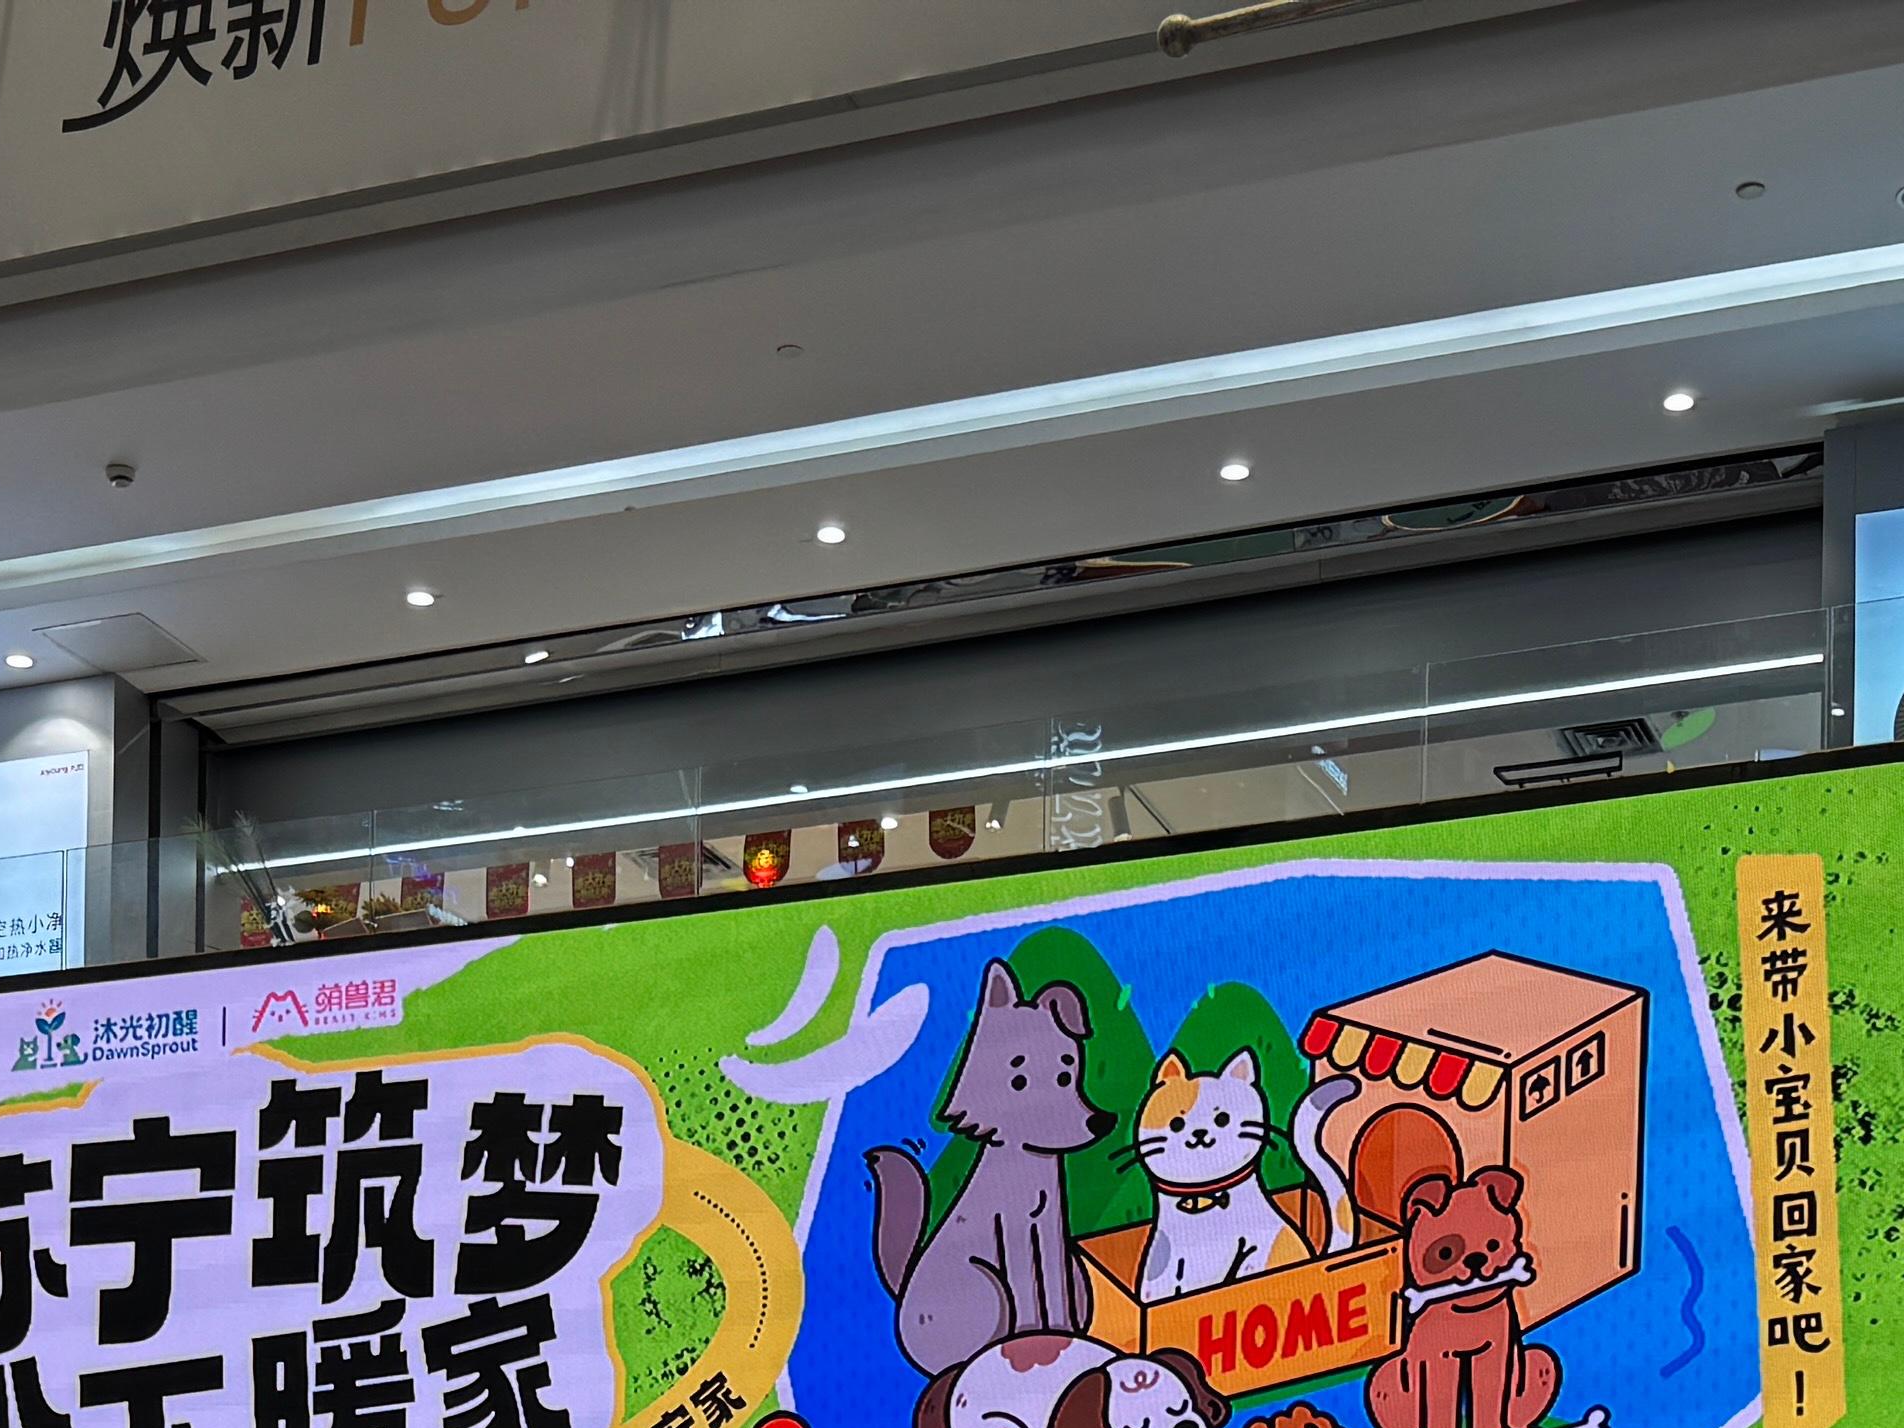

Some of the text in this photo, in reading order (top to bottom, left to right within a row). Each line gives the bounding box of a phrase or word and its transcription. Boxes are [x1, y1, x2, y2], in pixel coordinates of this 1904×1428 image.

[91, 1037, 199, 1062] DawnSprout
[92, 1009, 199, 1046] 沐光初醒
[1754, 888, 1832, 1417] 来带小宝贝回家吧！
[1194, 1282, 1372, 1376] HOME
